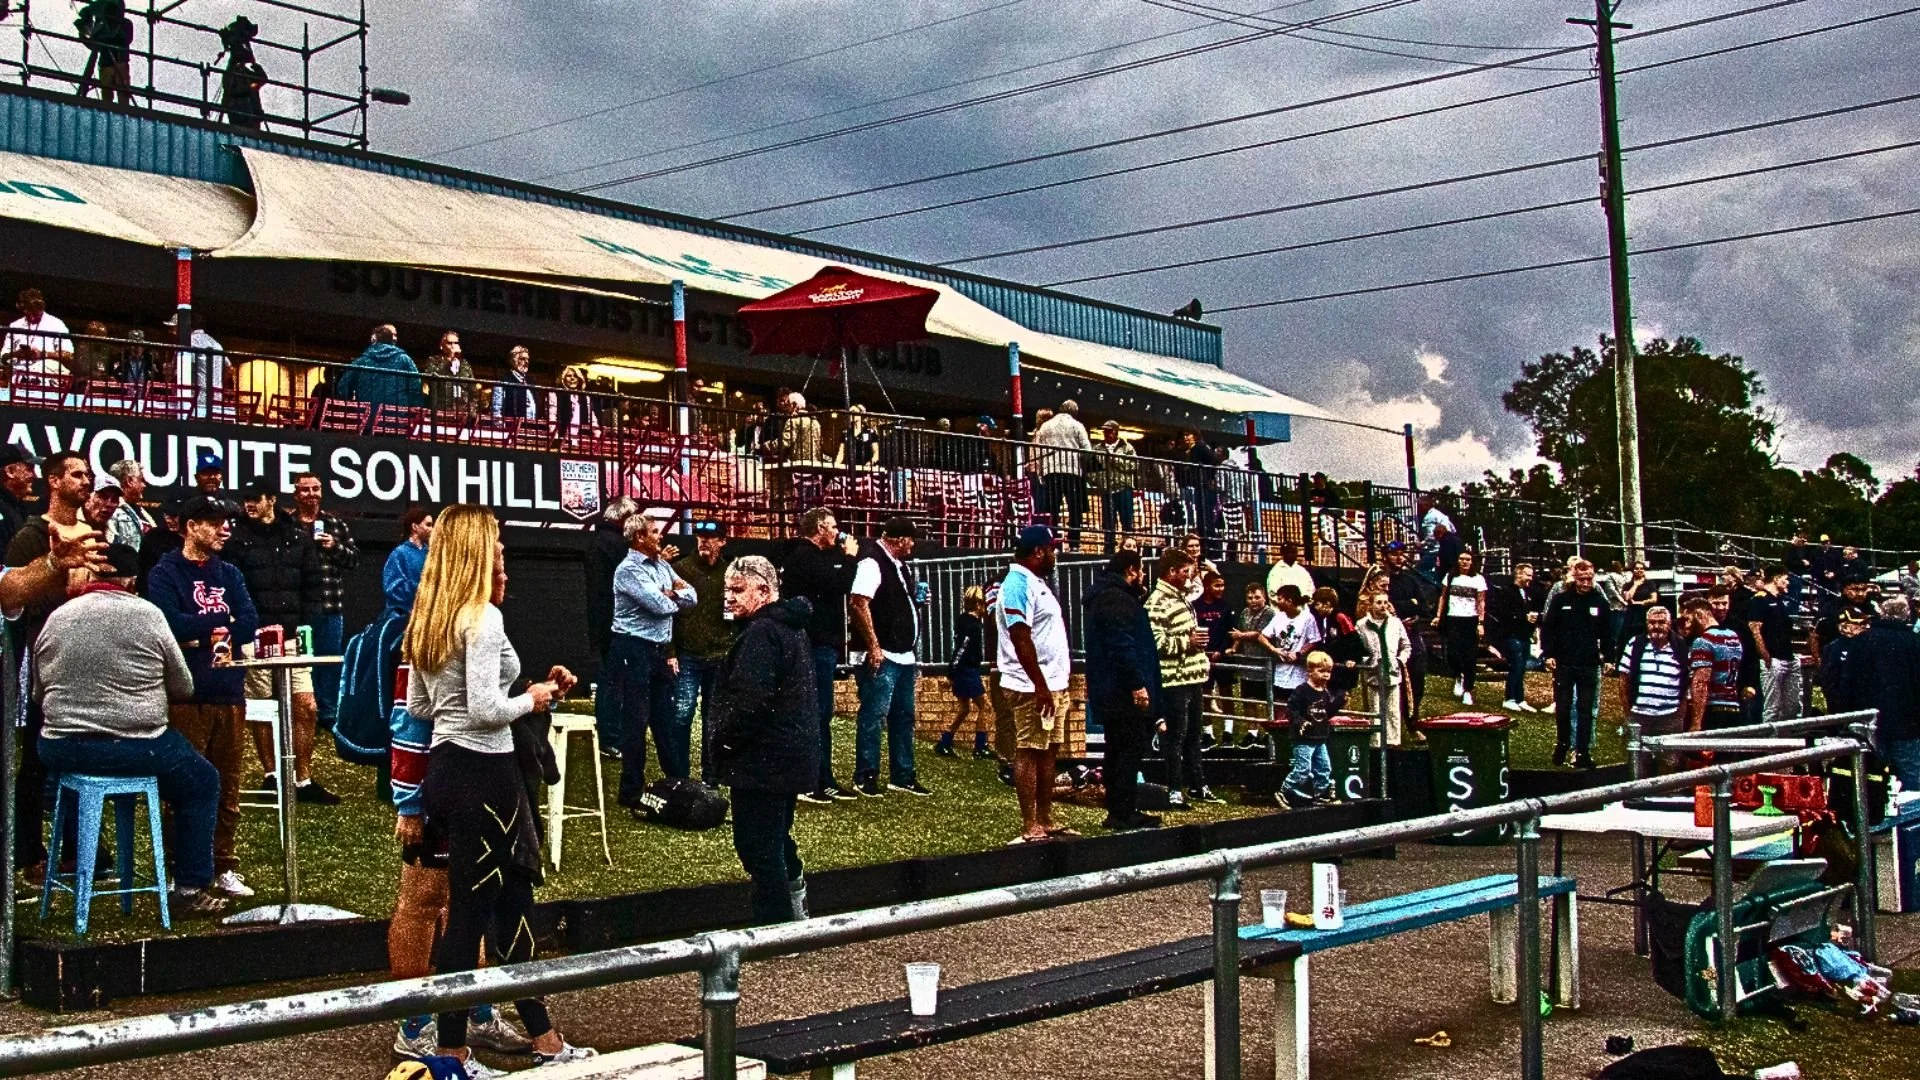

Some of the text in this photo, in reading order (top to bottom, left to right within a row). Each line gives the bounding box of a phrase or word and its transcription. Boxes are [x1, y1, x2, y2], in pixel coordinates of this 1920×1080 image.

[332, 261, 560, 321] SOUTHERN
[573, 294, 753, 350] DISTRCTS
[873, 343, 942, 376] CLUB
[330, 446, 441, 503] SON
[457, 457, 560, 510] HILL
[562, 462, 597, 473] SOUTHERN
[1446, 766, 1474, 801] S
